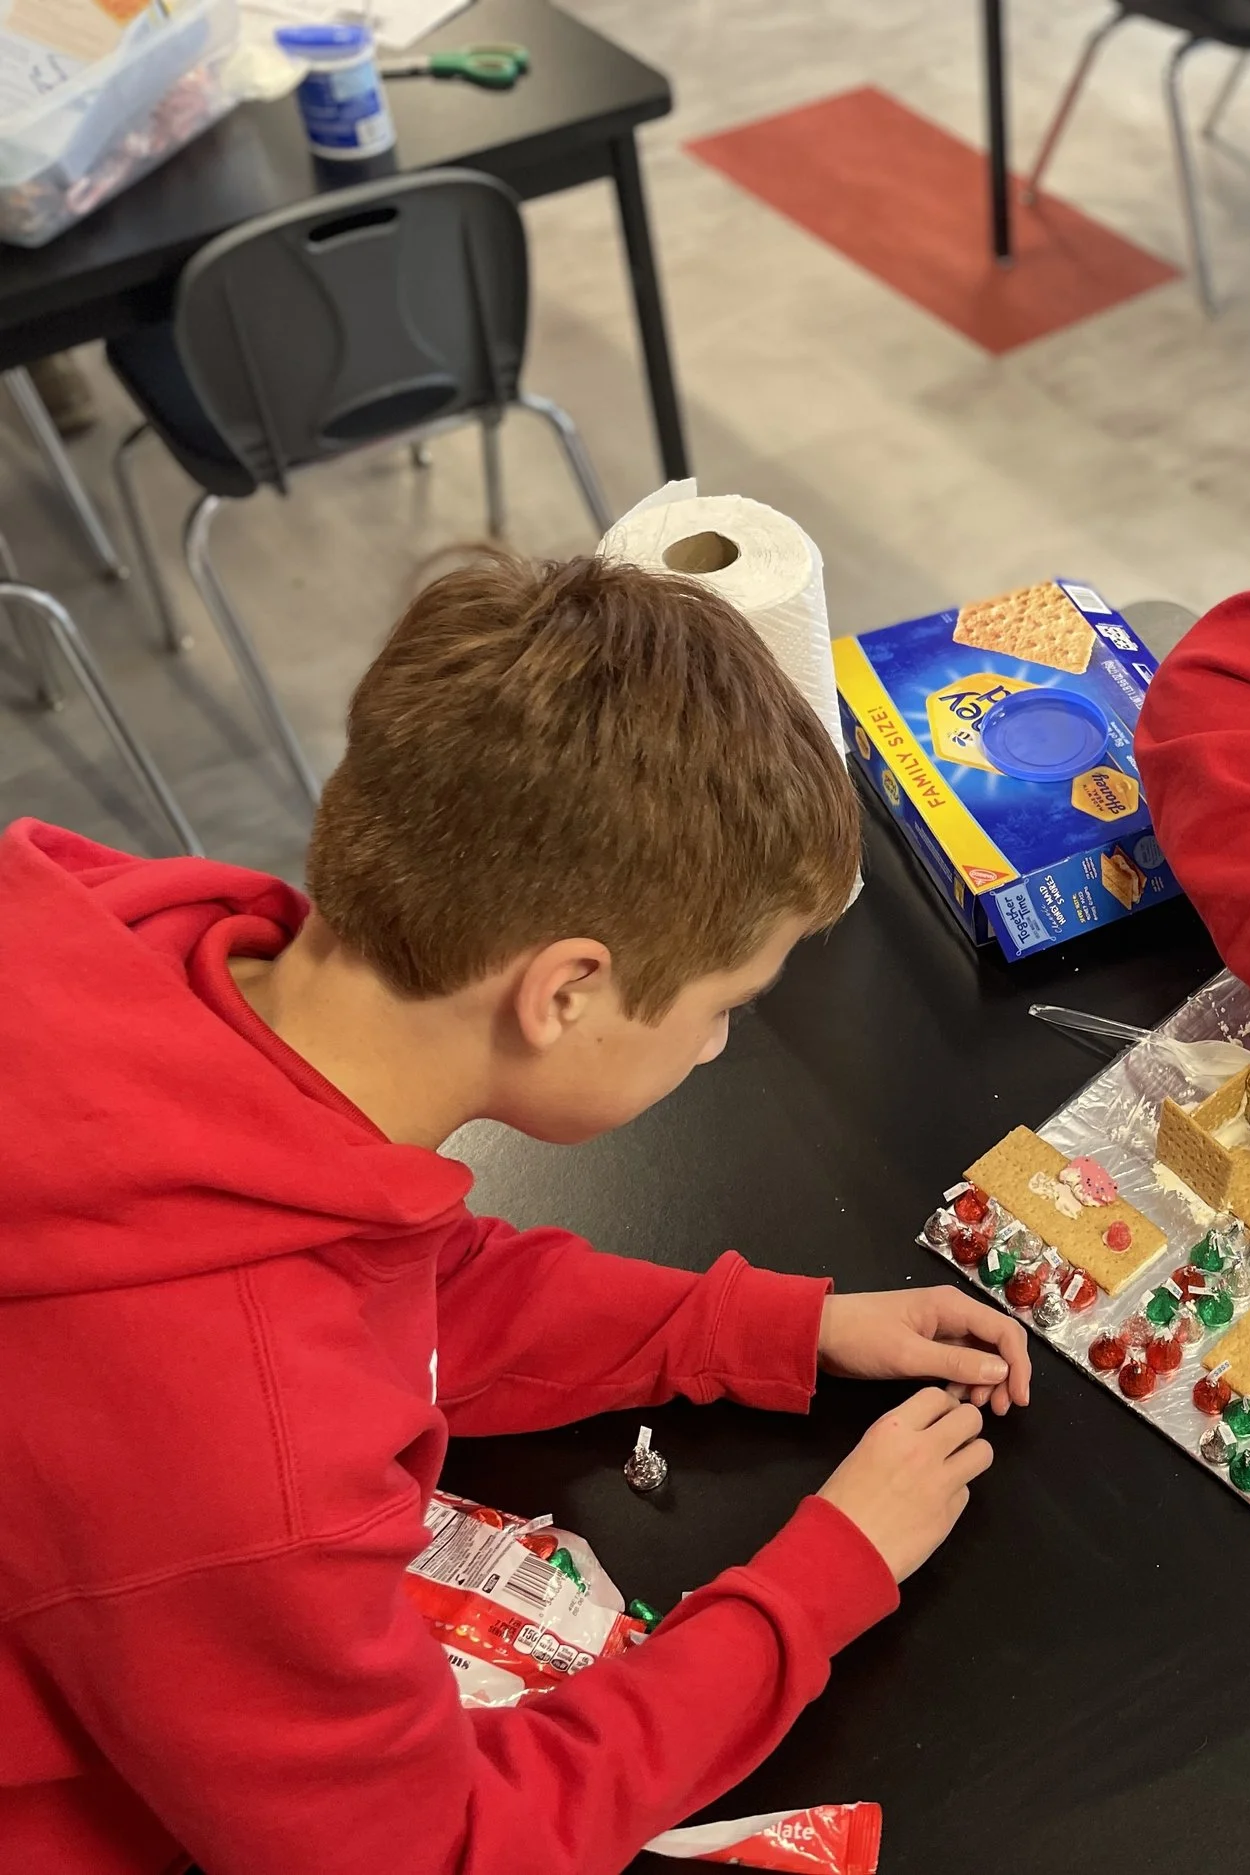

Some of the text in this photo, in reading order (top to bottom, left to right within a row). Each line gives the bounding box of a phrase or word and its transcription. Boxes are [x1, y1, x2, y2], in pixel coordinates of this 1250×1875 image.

[867, 705, 904, 748] SIZE!
[938, 691, 984, 732] ney
[897, 752, 946, 809] FAMILY
[1092, 774, 1126, 814] Honey
[1005, 897, 1030, 944] Together
[1016, 895, 1030, 919] Time
[1040, 885, 1066, 926] HONEY MAID
